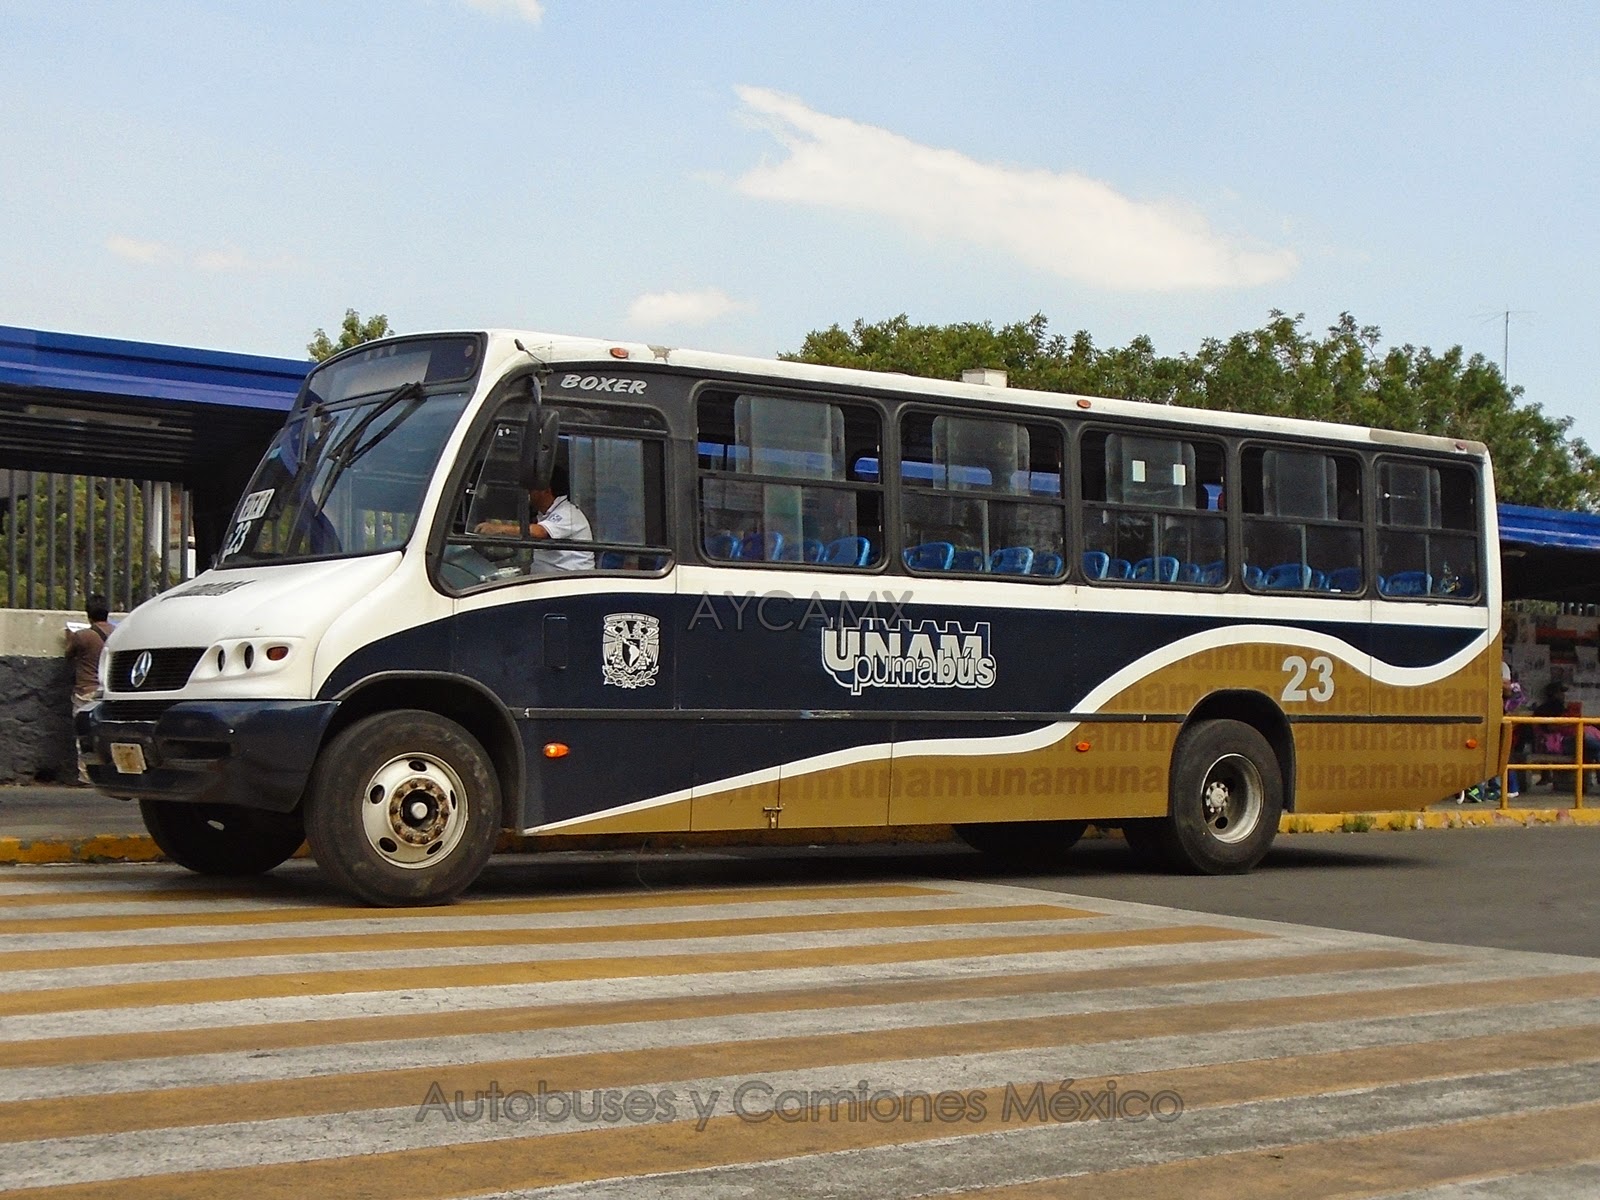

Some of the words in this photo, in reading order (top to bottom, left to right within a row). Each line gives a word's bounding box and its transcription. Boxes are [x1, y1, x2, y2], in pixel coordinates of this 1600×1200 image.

[560, 374, 648, 395] BOXER
[223, 520, 252, 556] 23
[822, 624, 987, 676] UNAM
[851, 646, 997, 695] pumabús
[1281, 655, 1334, 702] 23
